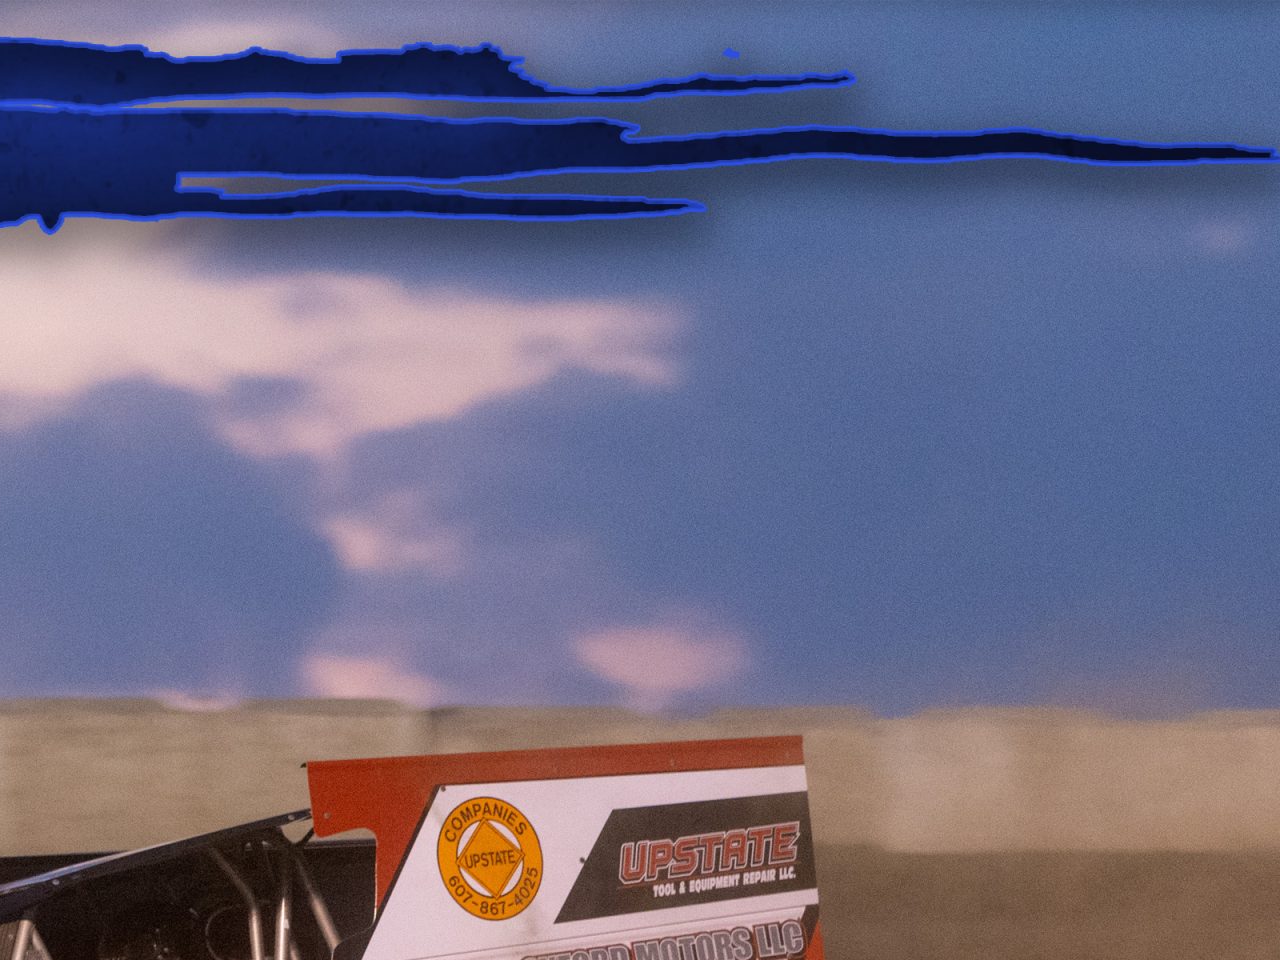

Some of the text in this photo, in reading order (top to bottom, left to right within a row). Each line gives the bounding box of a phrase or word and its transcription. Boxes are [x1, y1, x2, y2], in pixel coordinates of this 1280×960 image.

[445, 802, 527, 842] COMPANIES
[464, 849, 516, 869] UPSTATE
[619, 821, 800, 884] UPSTATE
[448, 867, 538, 915] 607-867-4025
[653, 866, 797, 898] TOOL & EQUIPMENT REPAIR LLC.
